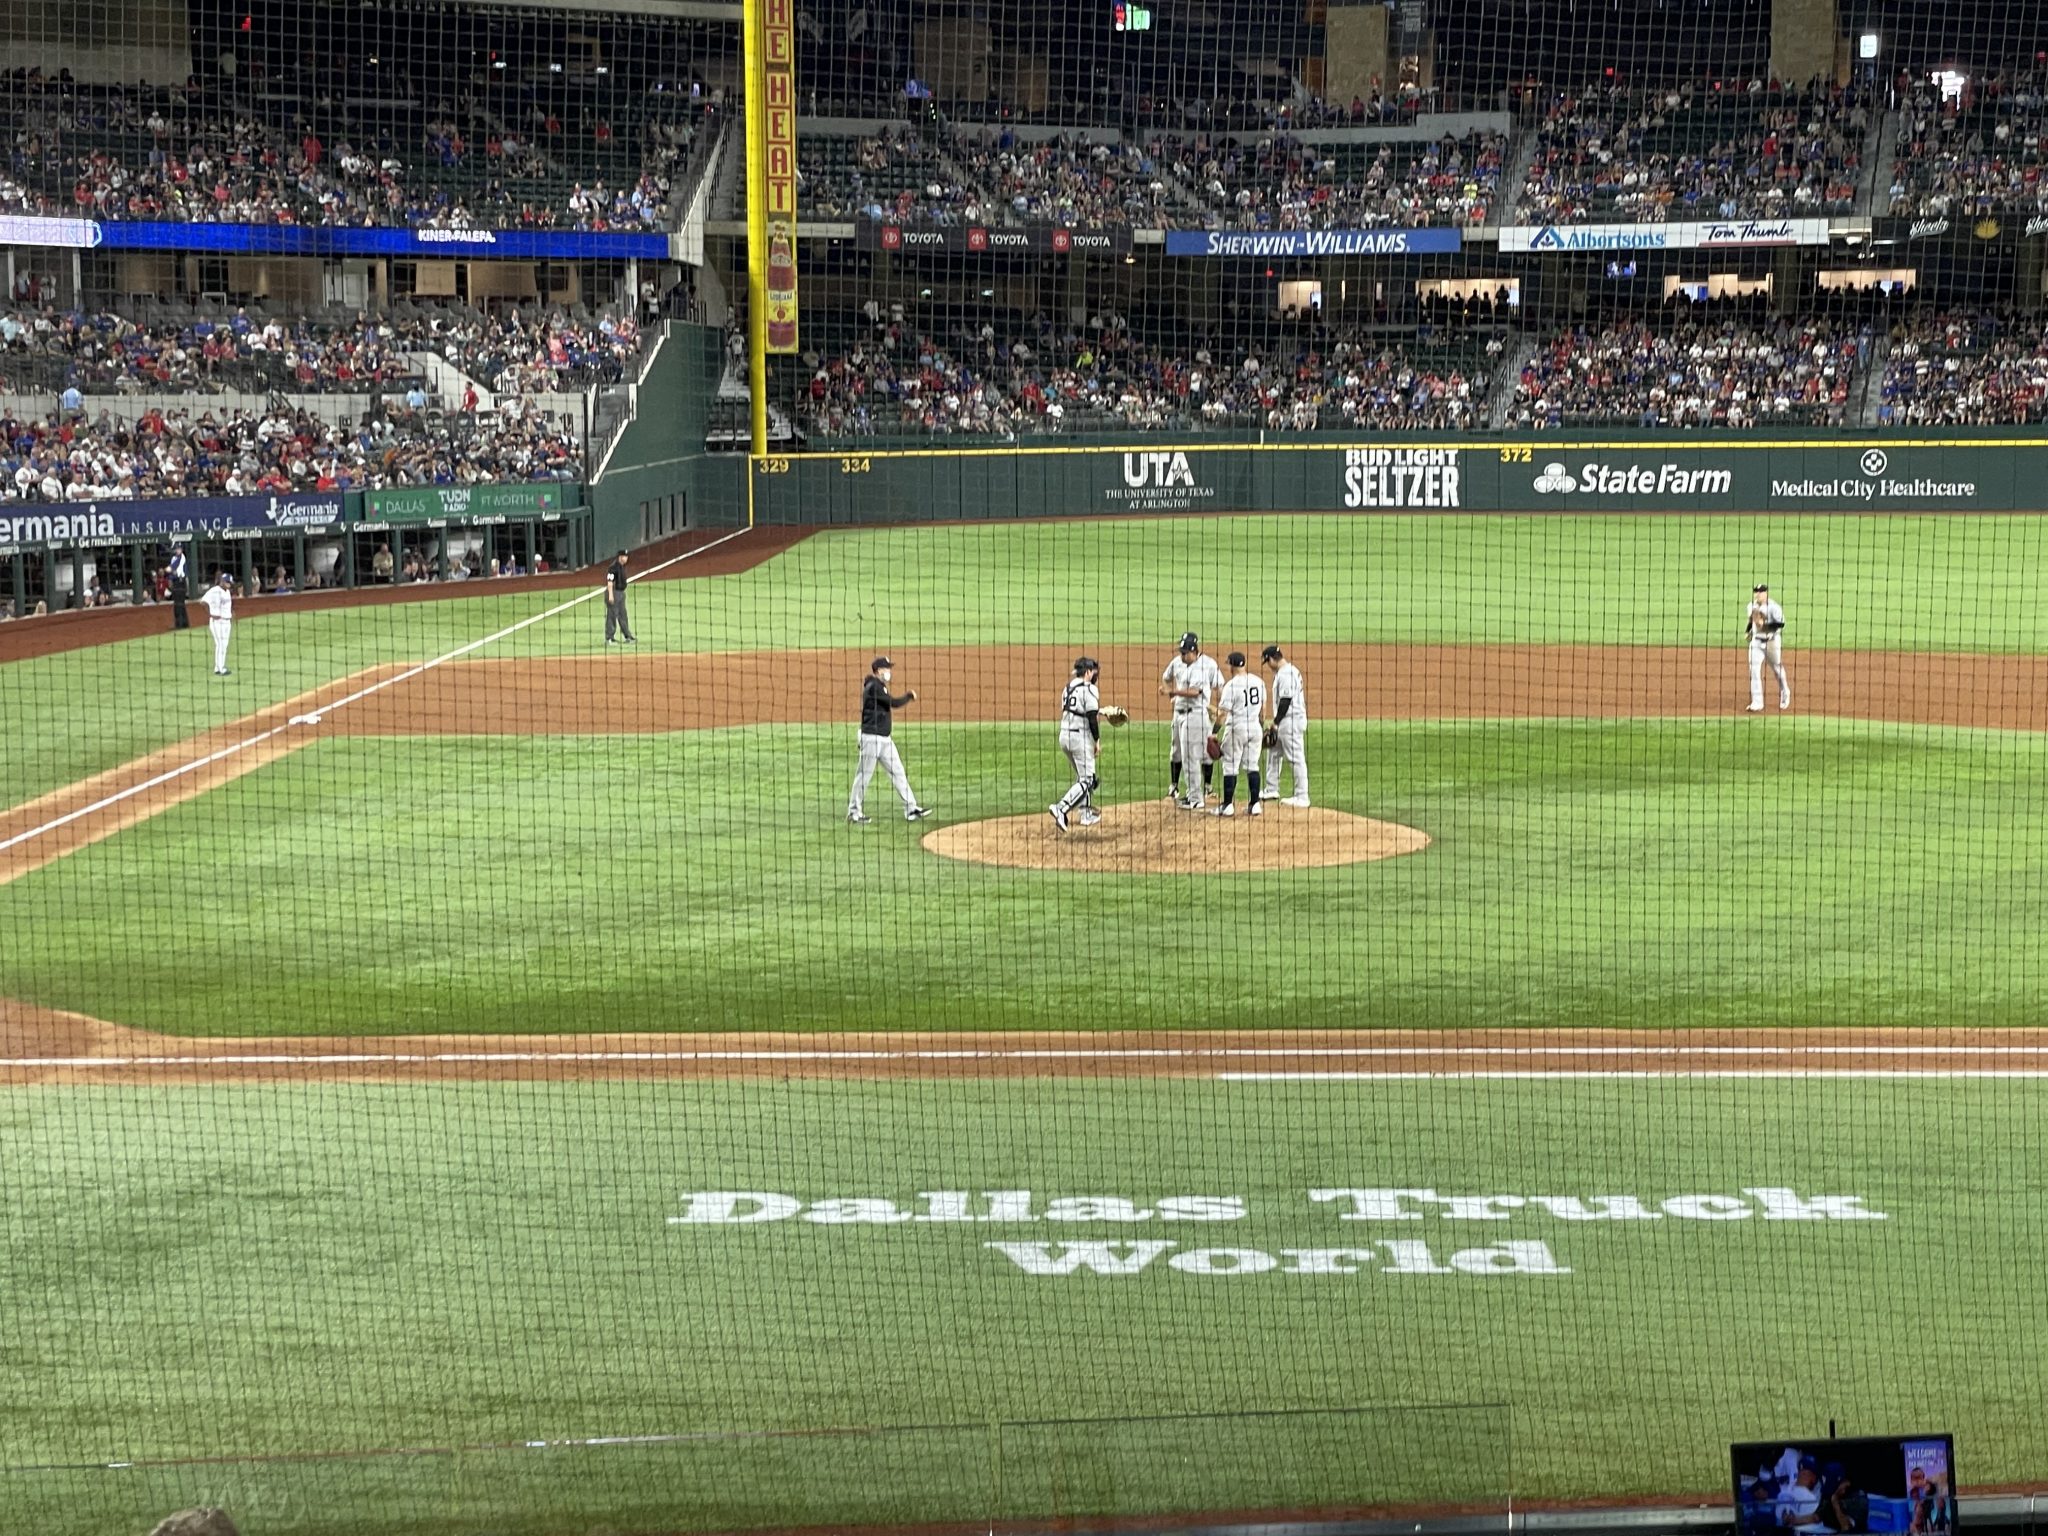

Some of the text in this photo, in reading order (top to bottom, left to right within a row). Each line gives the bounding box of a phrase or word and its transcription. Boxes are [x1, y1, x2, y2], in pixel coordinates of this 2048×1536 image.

[770, 76, 788, 210] HEAT
[1702, 220, 1793, 240] Tom Thumb
[903, 232, 944, 244] TOYOTA
[989, 233, 1029, 245] TOYOTA
[1072, 235, 1111, 247] TOYOTA
[1567, 232, 1665, 248] Albertsons
[1345, 448, 1459, 466] BUD LIGHT
[1500, 448, 1532, 463] 372
[760, 458, 789, 473] 329
[841, 458, 871, 473] 334
[1124, 452, 1195, 488] UTA
[1105, 487, 1214, 499] THE UNIVERSITY OF TEXAS
[1344, 466, 1459, 507] SELTZER
[1771, 479, 1975, 500] Medical City Healthcare
[438, 489, 471, 502] TUDN
[494, 495, 534, 505] WORTH
[287, 501, 338, 516] Germania
[386, 500, 426, 513] DALLAS
[444, 503, 467, 512] RADIO
[1129, 498, 1191, 509] AT ARLINGTON
[122, 517, 234, 534] INSURANCE
[222, 527, 262, 539] Germania
[353, 520, 390, 532] Germania
[78, 534, 122, 548] Germania
[1243, 687, 1260, 706] 18
[665, 1187, 1889, 1224] Dallas Truck
[984, 1239, 1573, 1275] World
